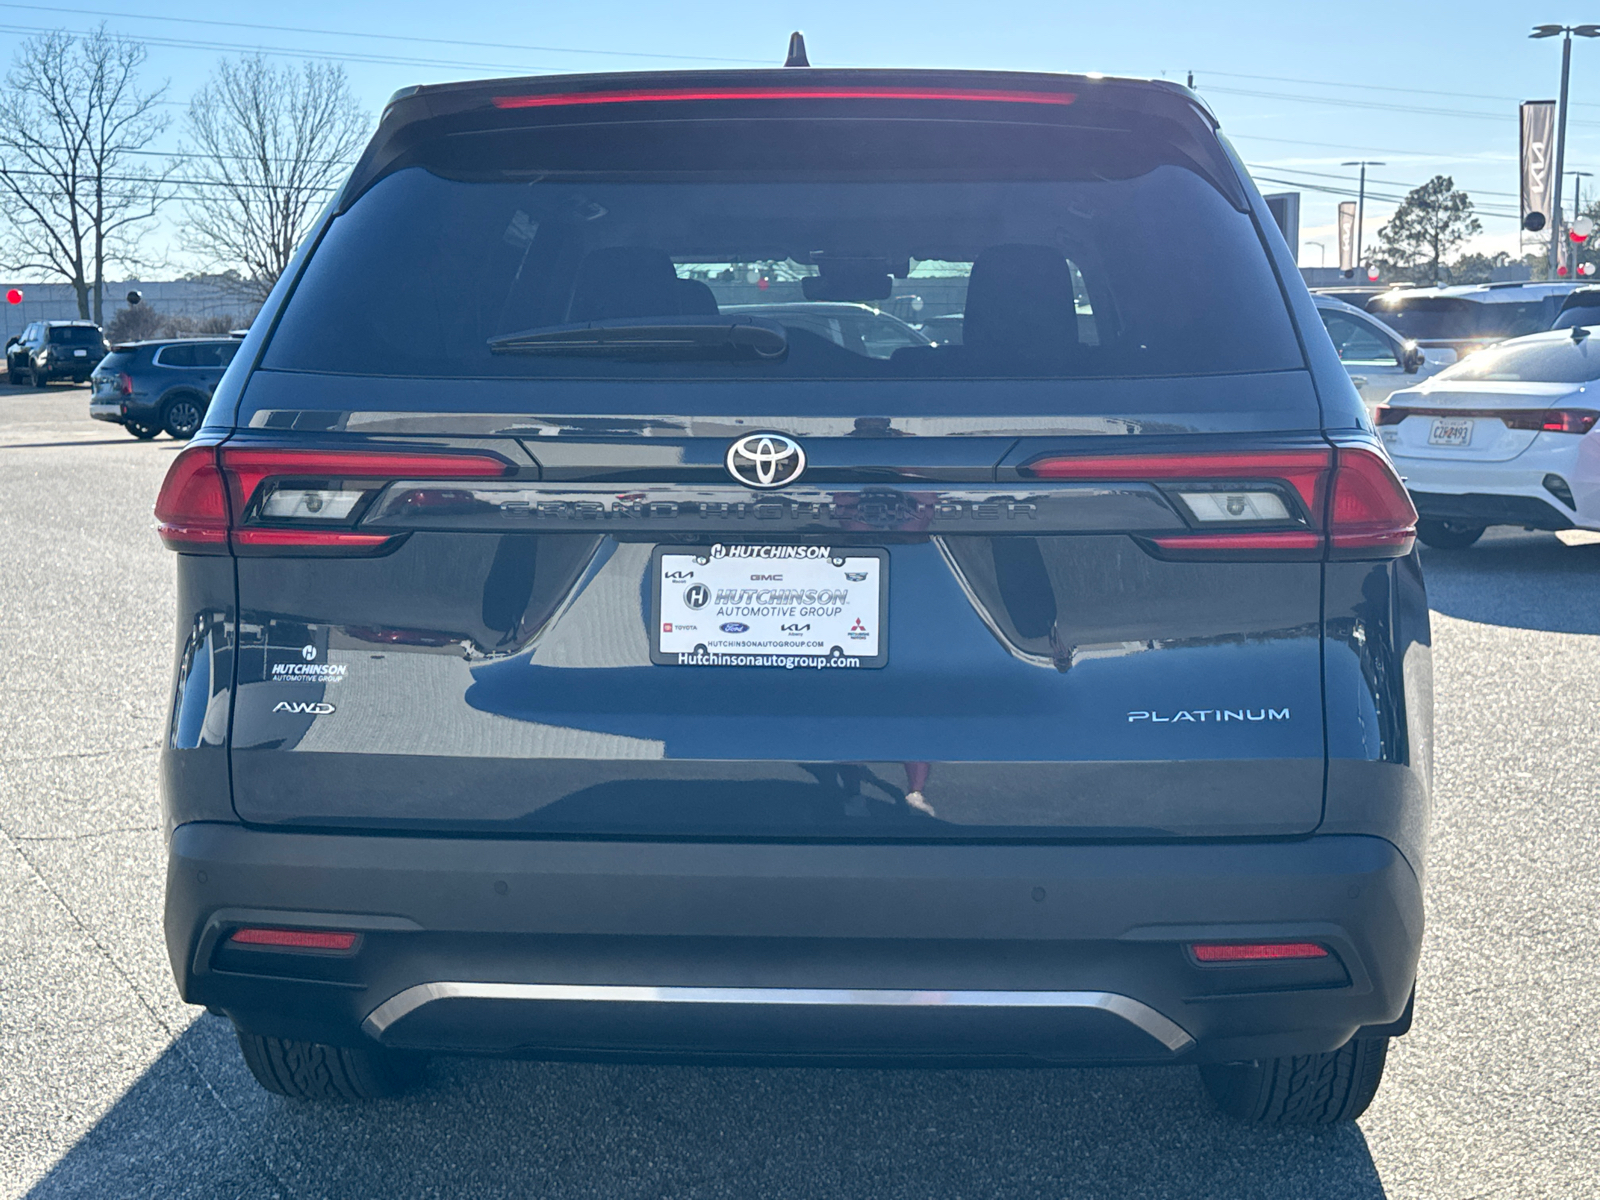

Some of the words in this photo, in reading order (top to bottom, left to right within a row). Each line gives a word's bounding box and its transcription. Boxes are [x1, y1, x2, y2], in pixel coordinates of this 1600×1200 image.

[500, 501, 679, 520] GRAND
[700, 502, 1037, 521] HIGHLANDER
[729, 545, 831, 559] HUTCHINSON
[714, 588, 849, 606] HUTCHINSON
[716, 606, 797, 617] AUTOMOTIVE
[799, 606, 842, 617] GROUP
[707, 640, 824, 648] HUTCHINSONAUTOGROUP.COM
[678, 652, 860, 669] Hutchinsonautogroup.com
[272, 663, 347, 675] HUTCHINSON
[272, 674, 317, 682] AUTOMOTIVE
[318, 675, 343, 683] GROUP
[272, 701, 337, 714] AWD
[1127, 708, 1290, 723] PLATINUM
